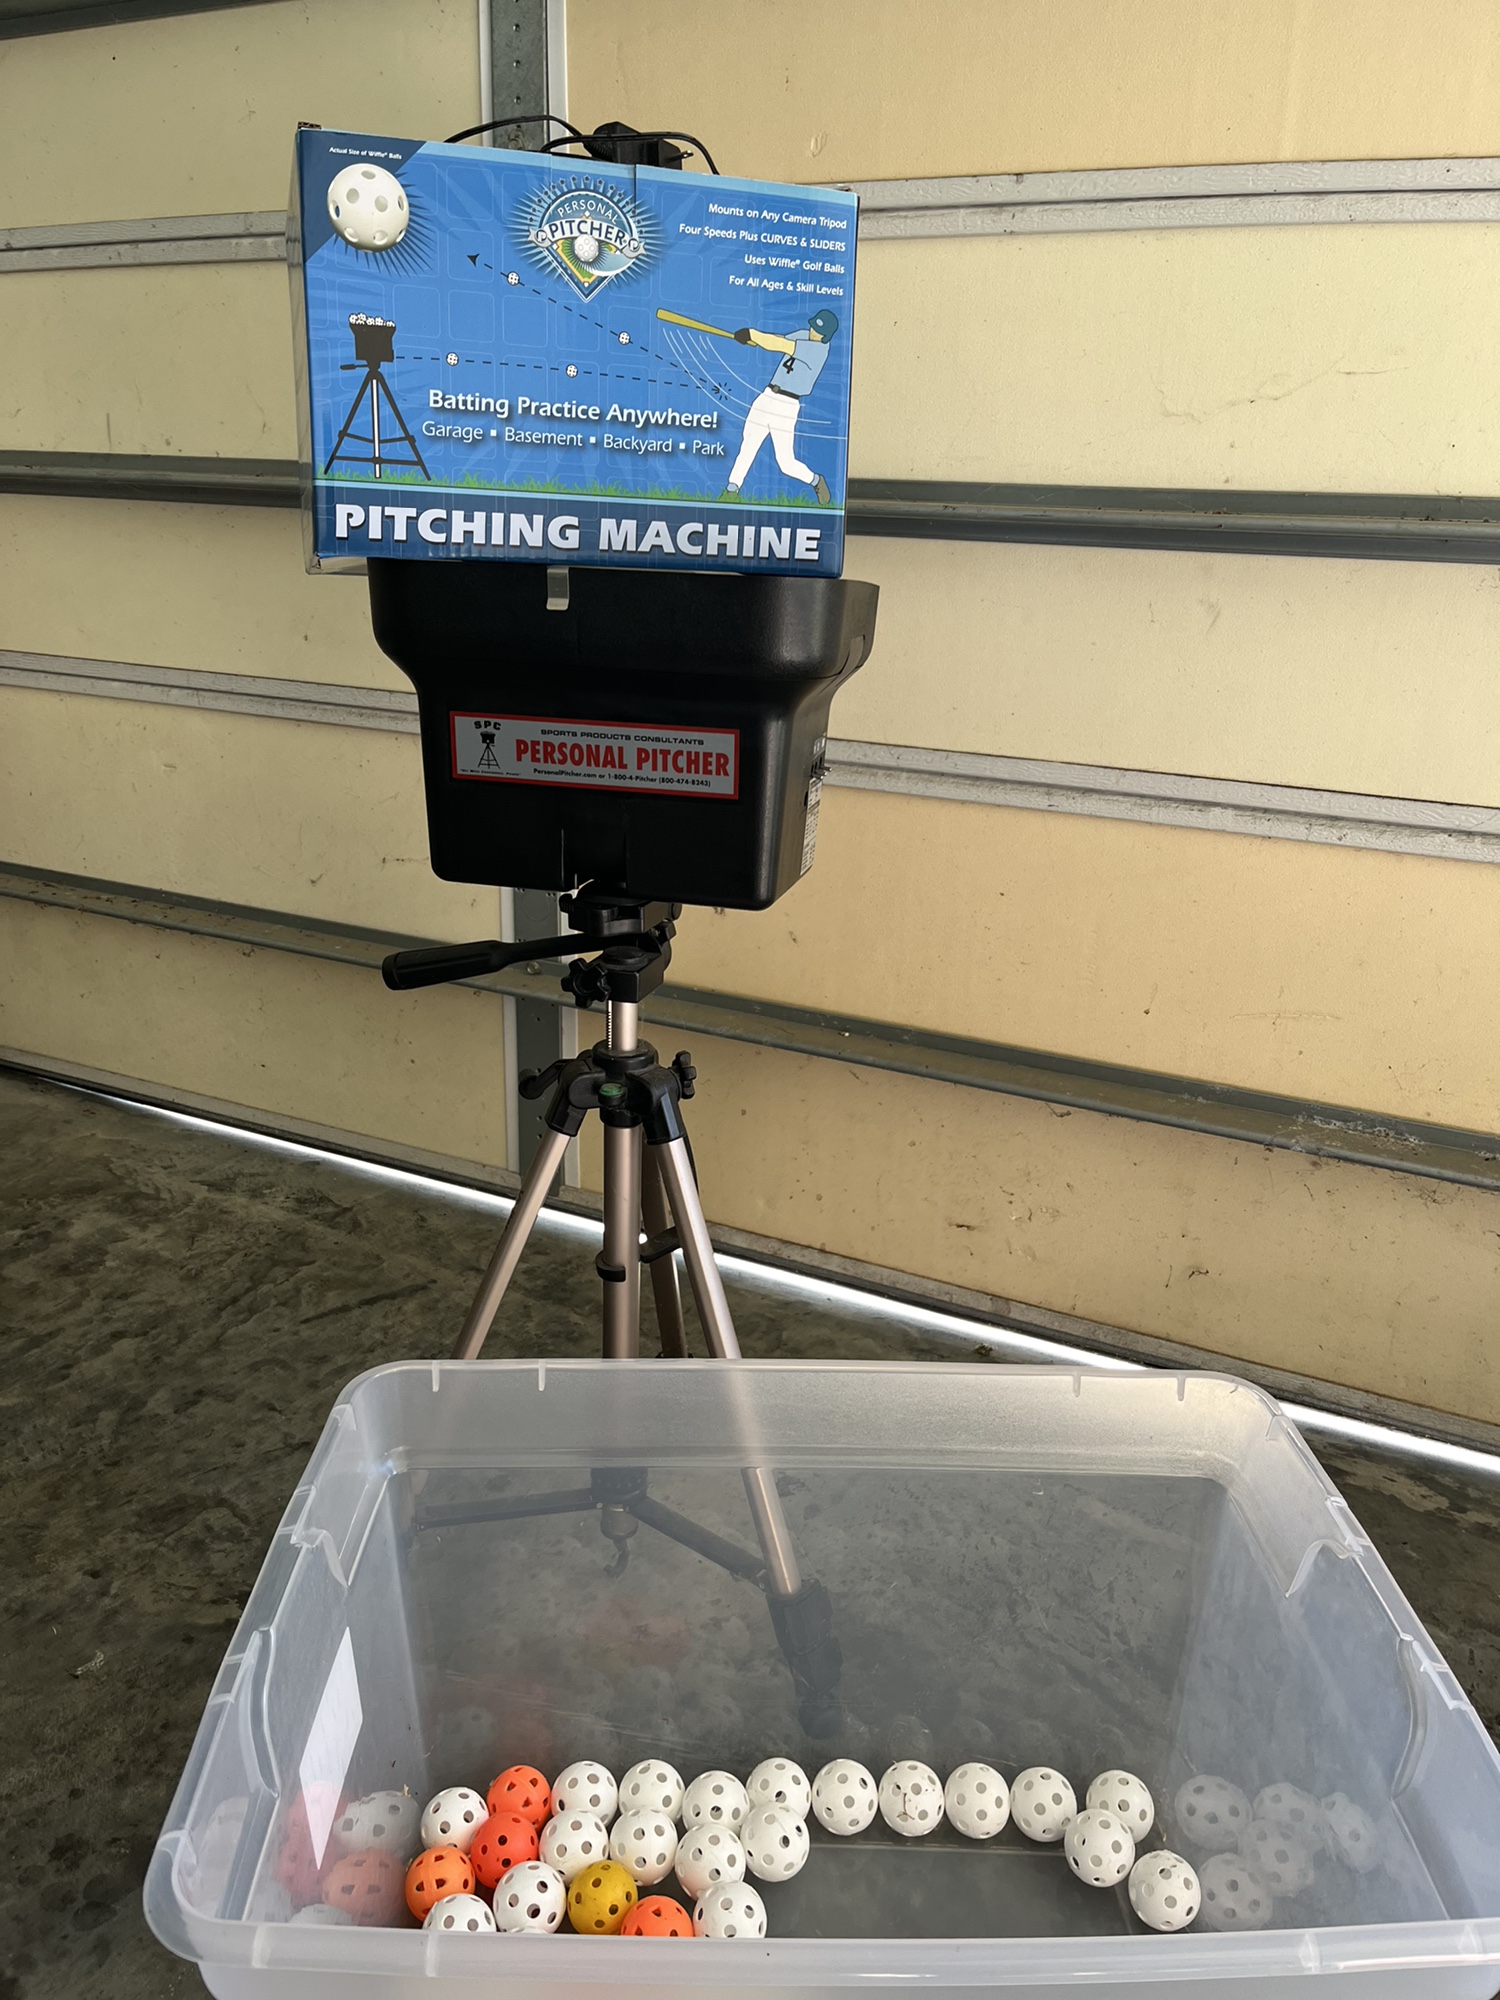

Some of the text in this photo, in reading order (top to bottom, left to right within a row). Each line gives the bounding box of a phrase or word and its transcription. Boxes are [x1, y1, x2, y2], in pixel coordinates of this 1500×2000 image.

[329, 147, 348, 155] Actual
[348, 148, 360, 156] Size
[388, 152, 402, 160] Balls
[557, 199, 619, 225] PERSONAL
[708, 203, 847, 230] Mounts on Any Camera Tripod
[679, 223, 846, 252] Four Speeds Plus CURVES & SLIDERS
[744, 253, 766, 266] Uses
[802, 260, 823, 272] Golf
[824, 264, 845, 274] Balls
[729, 275, 844, 296] For All Ages & Skill Levels
[782, 356, 796, 375] 4
[428, 389, 719, 429] Batting Practice Anywhere!
[421, 420, 725, 456] Garage Basement Backyard Park
[334, 503, 821, 561] PITCHING MACHINE
[540, 728, 705, 746] SPORTS PRODUCTS CONSULTANTS
[515, 738, 730, 777] PERSONAL PITCHER
[533, 767, 597, 779] PersonalPitcher.com
[607, 772, 658, 784] 1-800-4-Pitcher
[658, 775, 711, 788] (800-474-8243)
